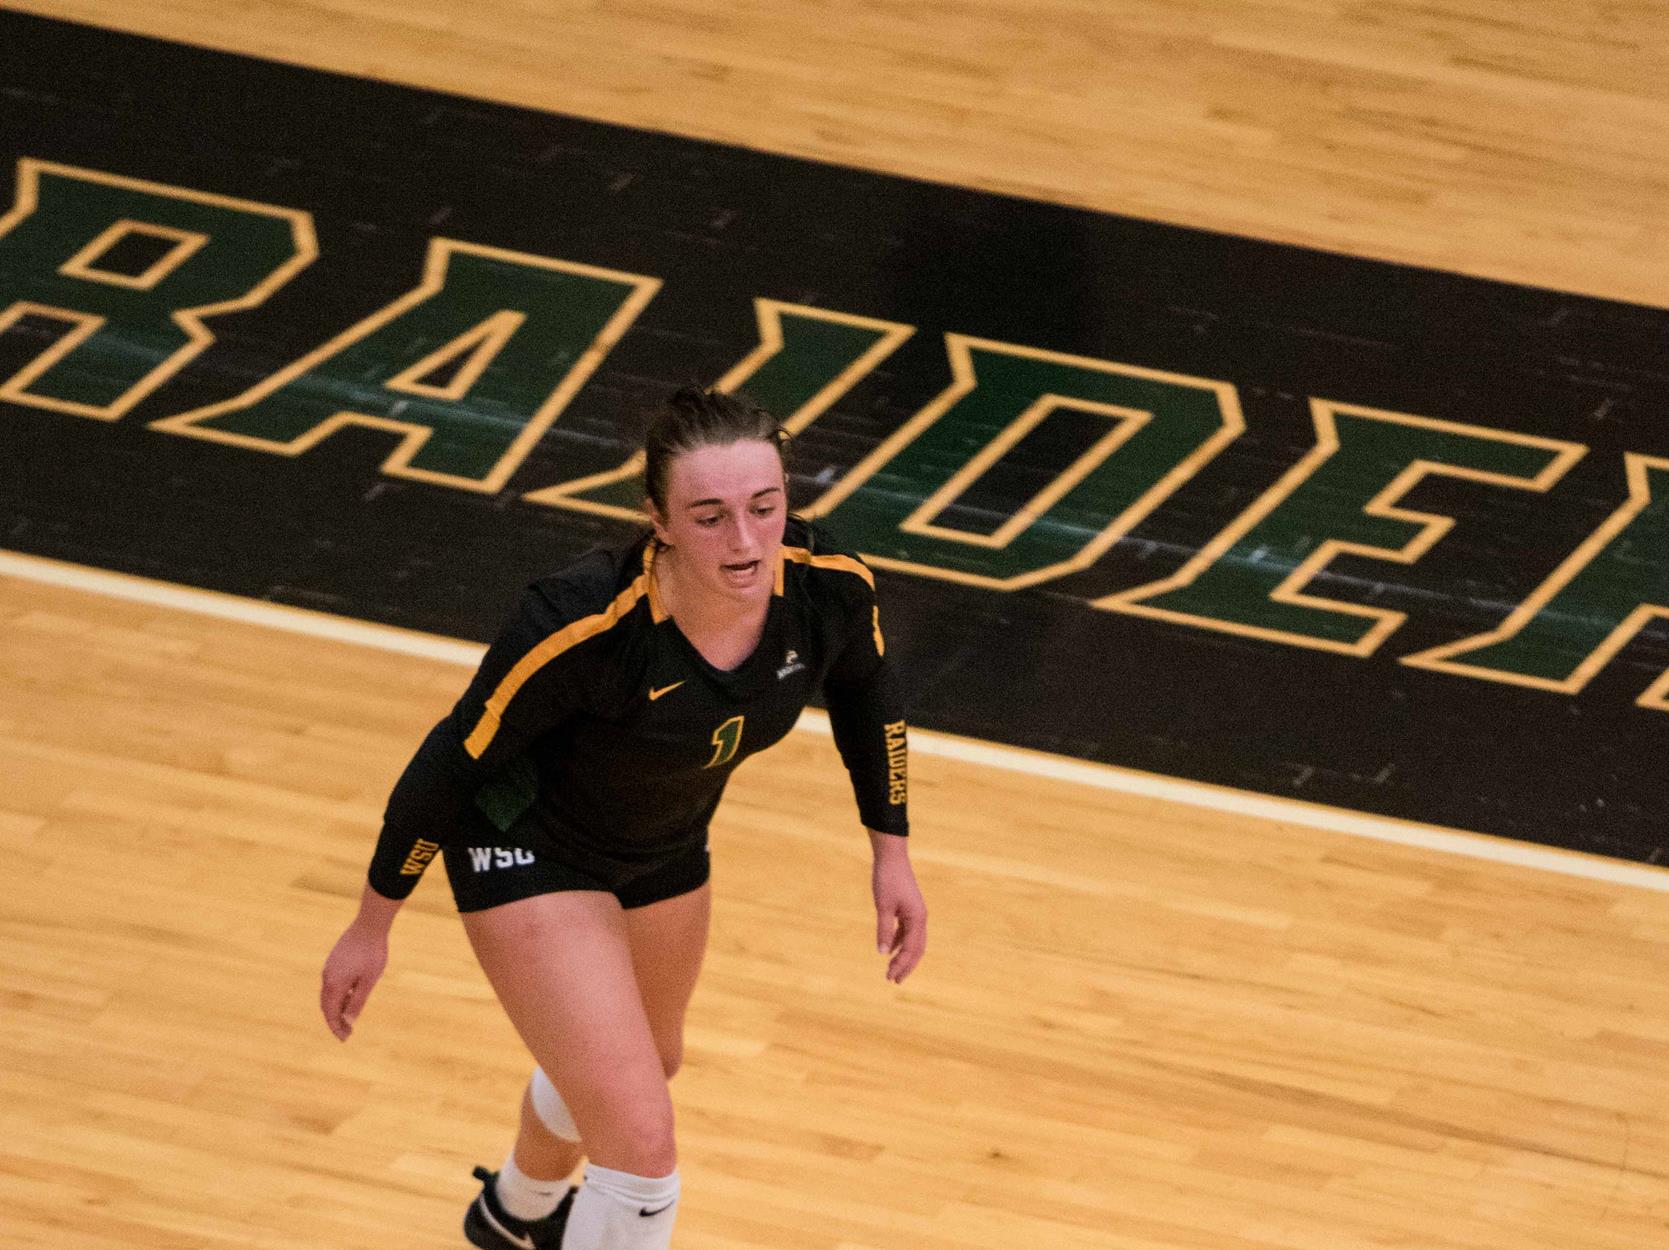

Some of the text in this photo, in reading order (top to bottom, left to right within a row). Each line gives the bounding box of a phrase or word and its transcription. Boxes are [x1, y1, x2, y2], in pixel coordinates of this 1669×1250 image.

[704, 715, 744, 769] 1
[884, 720, 907, 805] RAIDERS
[401, 838, 440, 876] WSU
